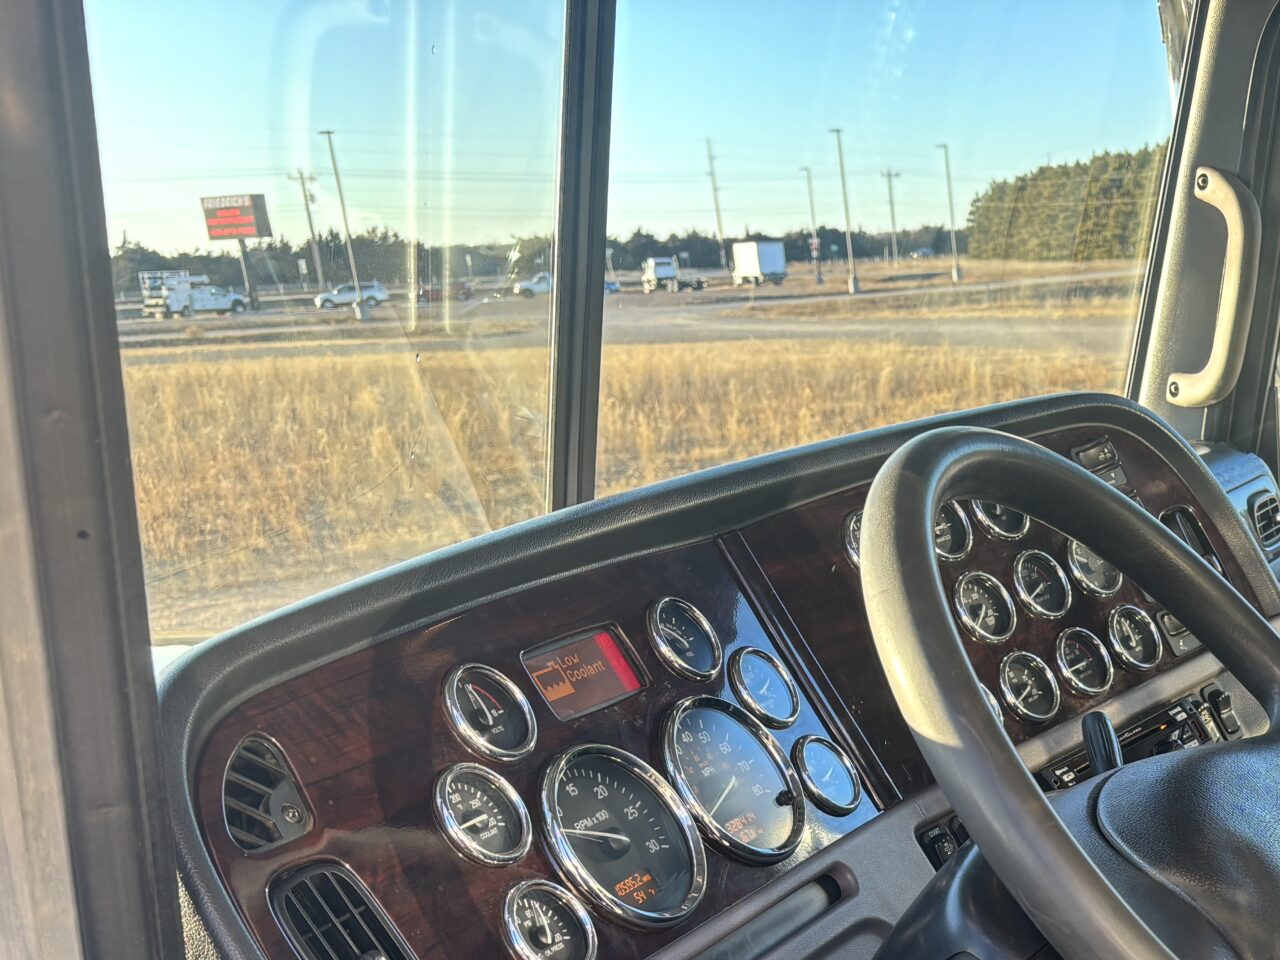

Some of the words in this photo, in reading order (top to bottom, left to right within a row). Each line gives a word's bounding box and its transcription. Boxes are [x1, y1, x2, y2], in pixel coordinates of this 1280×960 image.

[557, 653, 580, 669] Low
[566, 660, 606, 682] Coolant
[681, 731, 693, 743] 40
[698, 731, 711, 744] 50
[719, 742, 731, 754] 60
[737, 761, 750, 772] 70
[565, 783, 579, 797] 15
[594, 785, 608, 799] 20
[751, 784, 763, 797] 80
[624, 807, 639, 820] 25
[646, 839, 660, 854] 30
[633, 890, 647, 904] 54
